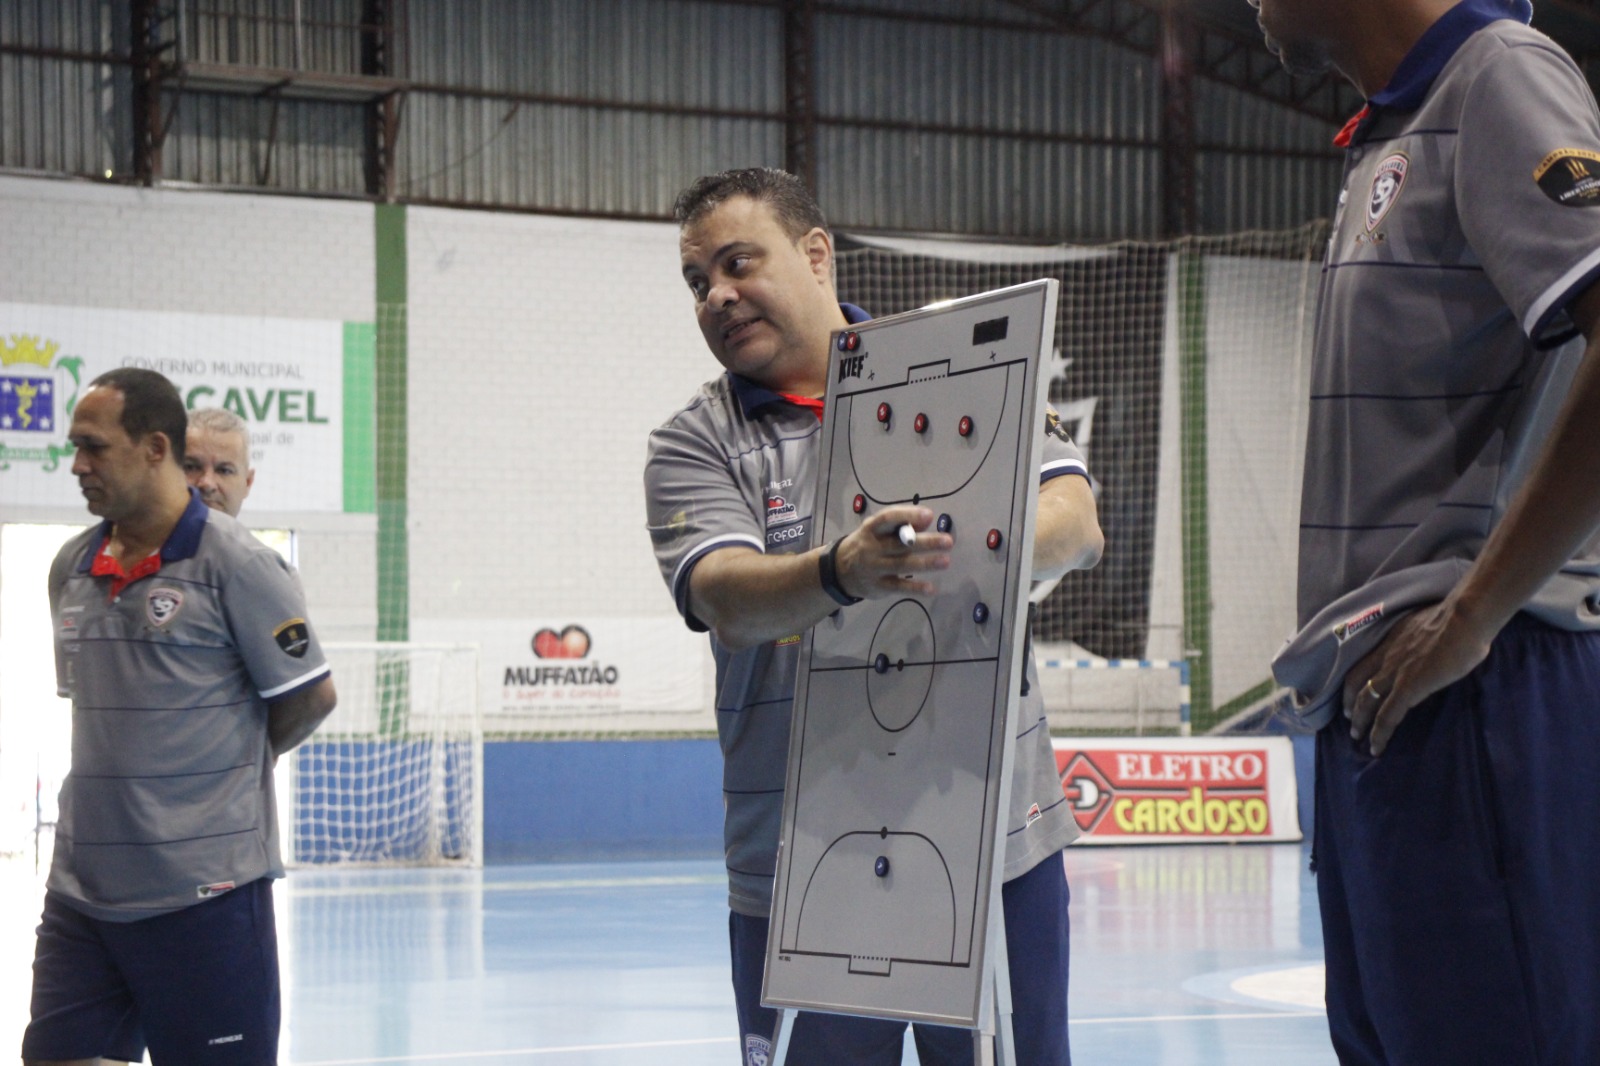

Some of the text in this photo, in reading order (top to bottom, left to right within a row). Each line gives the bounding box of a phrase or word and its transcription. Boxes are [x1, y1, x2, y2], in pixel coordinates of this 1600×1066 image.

[213, 359, 304, 379] MUNICIPAL
[503, 660, 618, 686] MUFFATÃO
[1117, 753, 1262, 781] ELETRO
